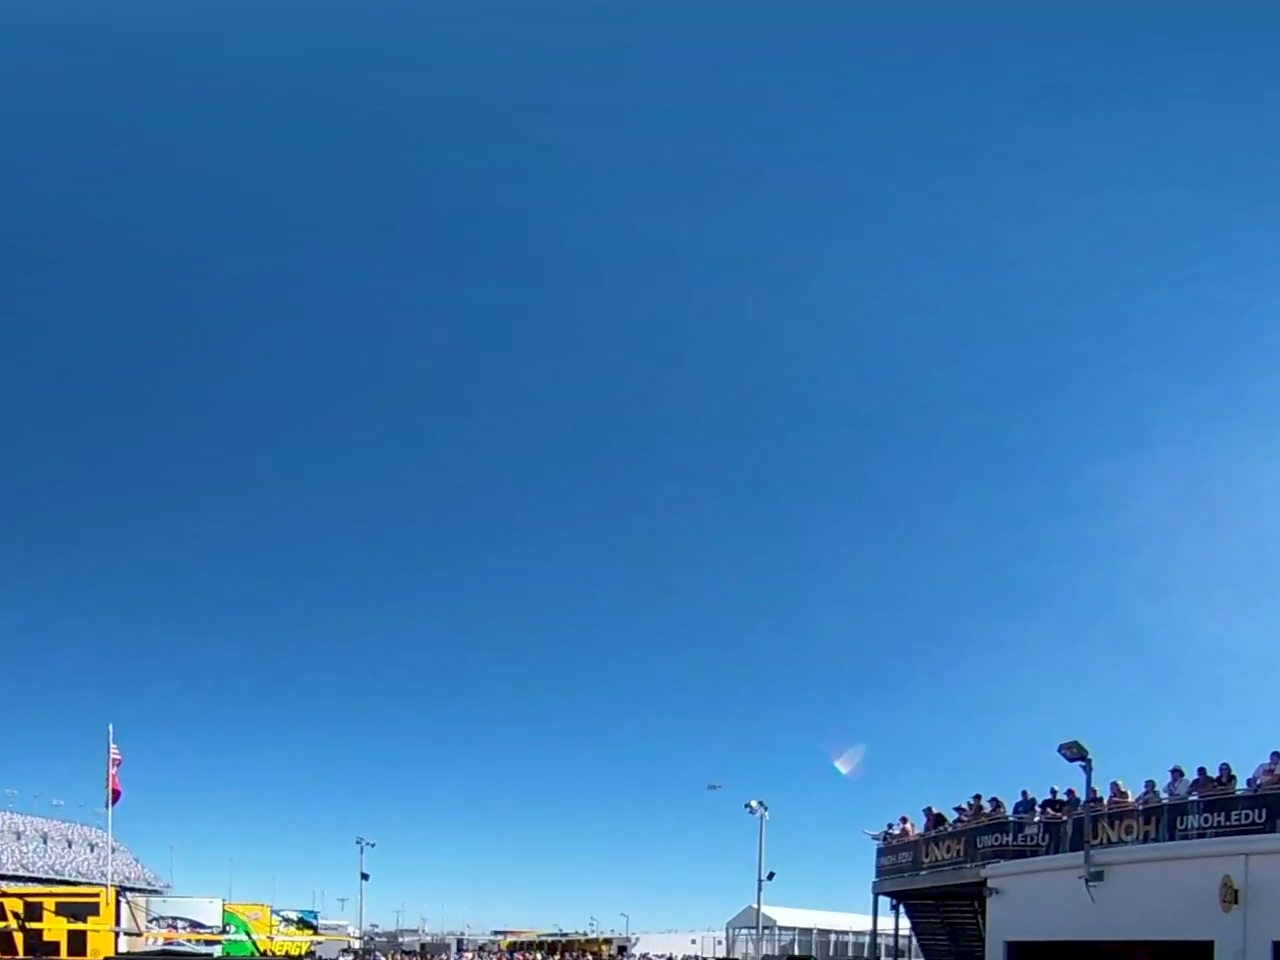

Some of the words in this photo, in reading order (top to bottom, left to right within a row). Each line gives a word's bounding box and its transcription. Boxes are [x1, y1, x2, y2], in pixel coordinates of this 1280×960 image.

[1089, 815, 1157, 846] UNOH
[1176, 807, 1267, 831] UNOH.EDU
[922, 836, 966, 864] UNOH
[976, 830, 1050, 849] UNOH.EDU
